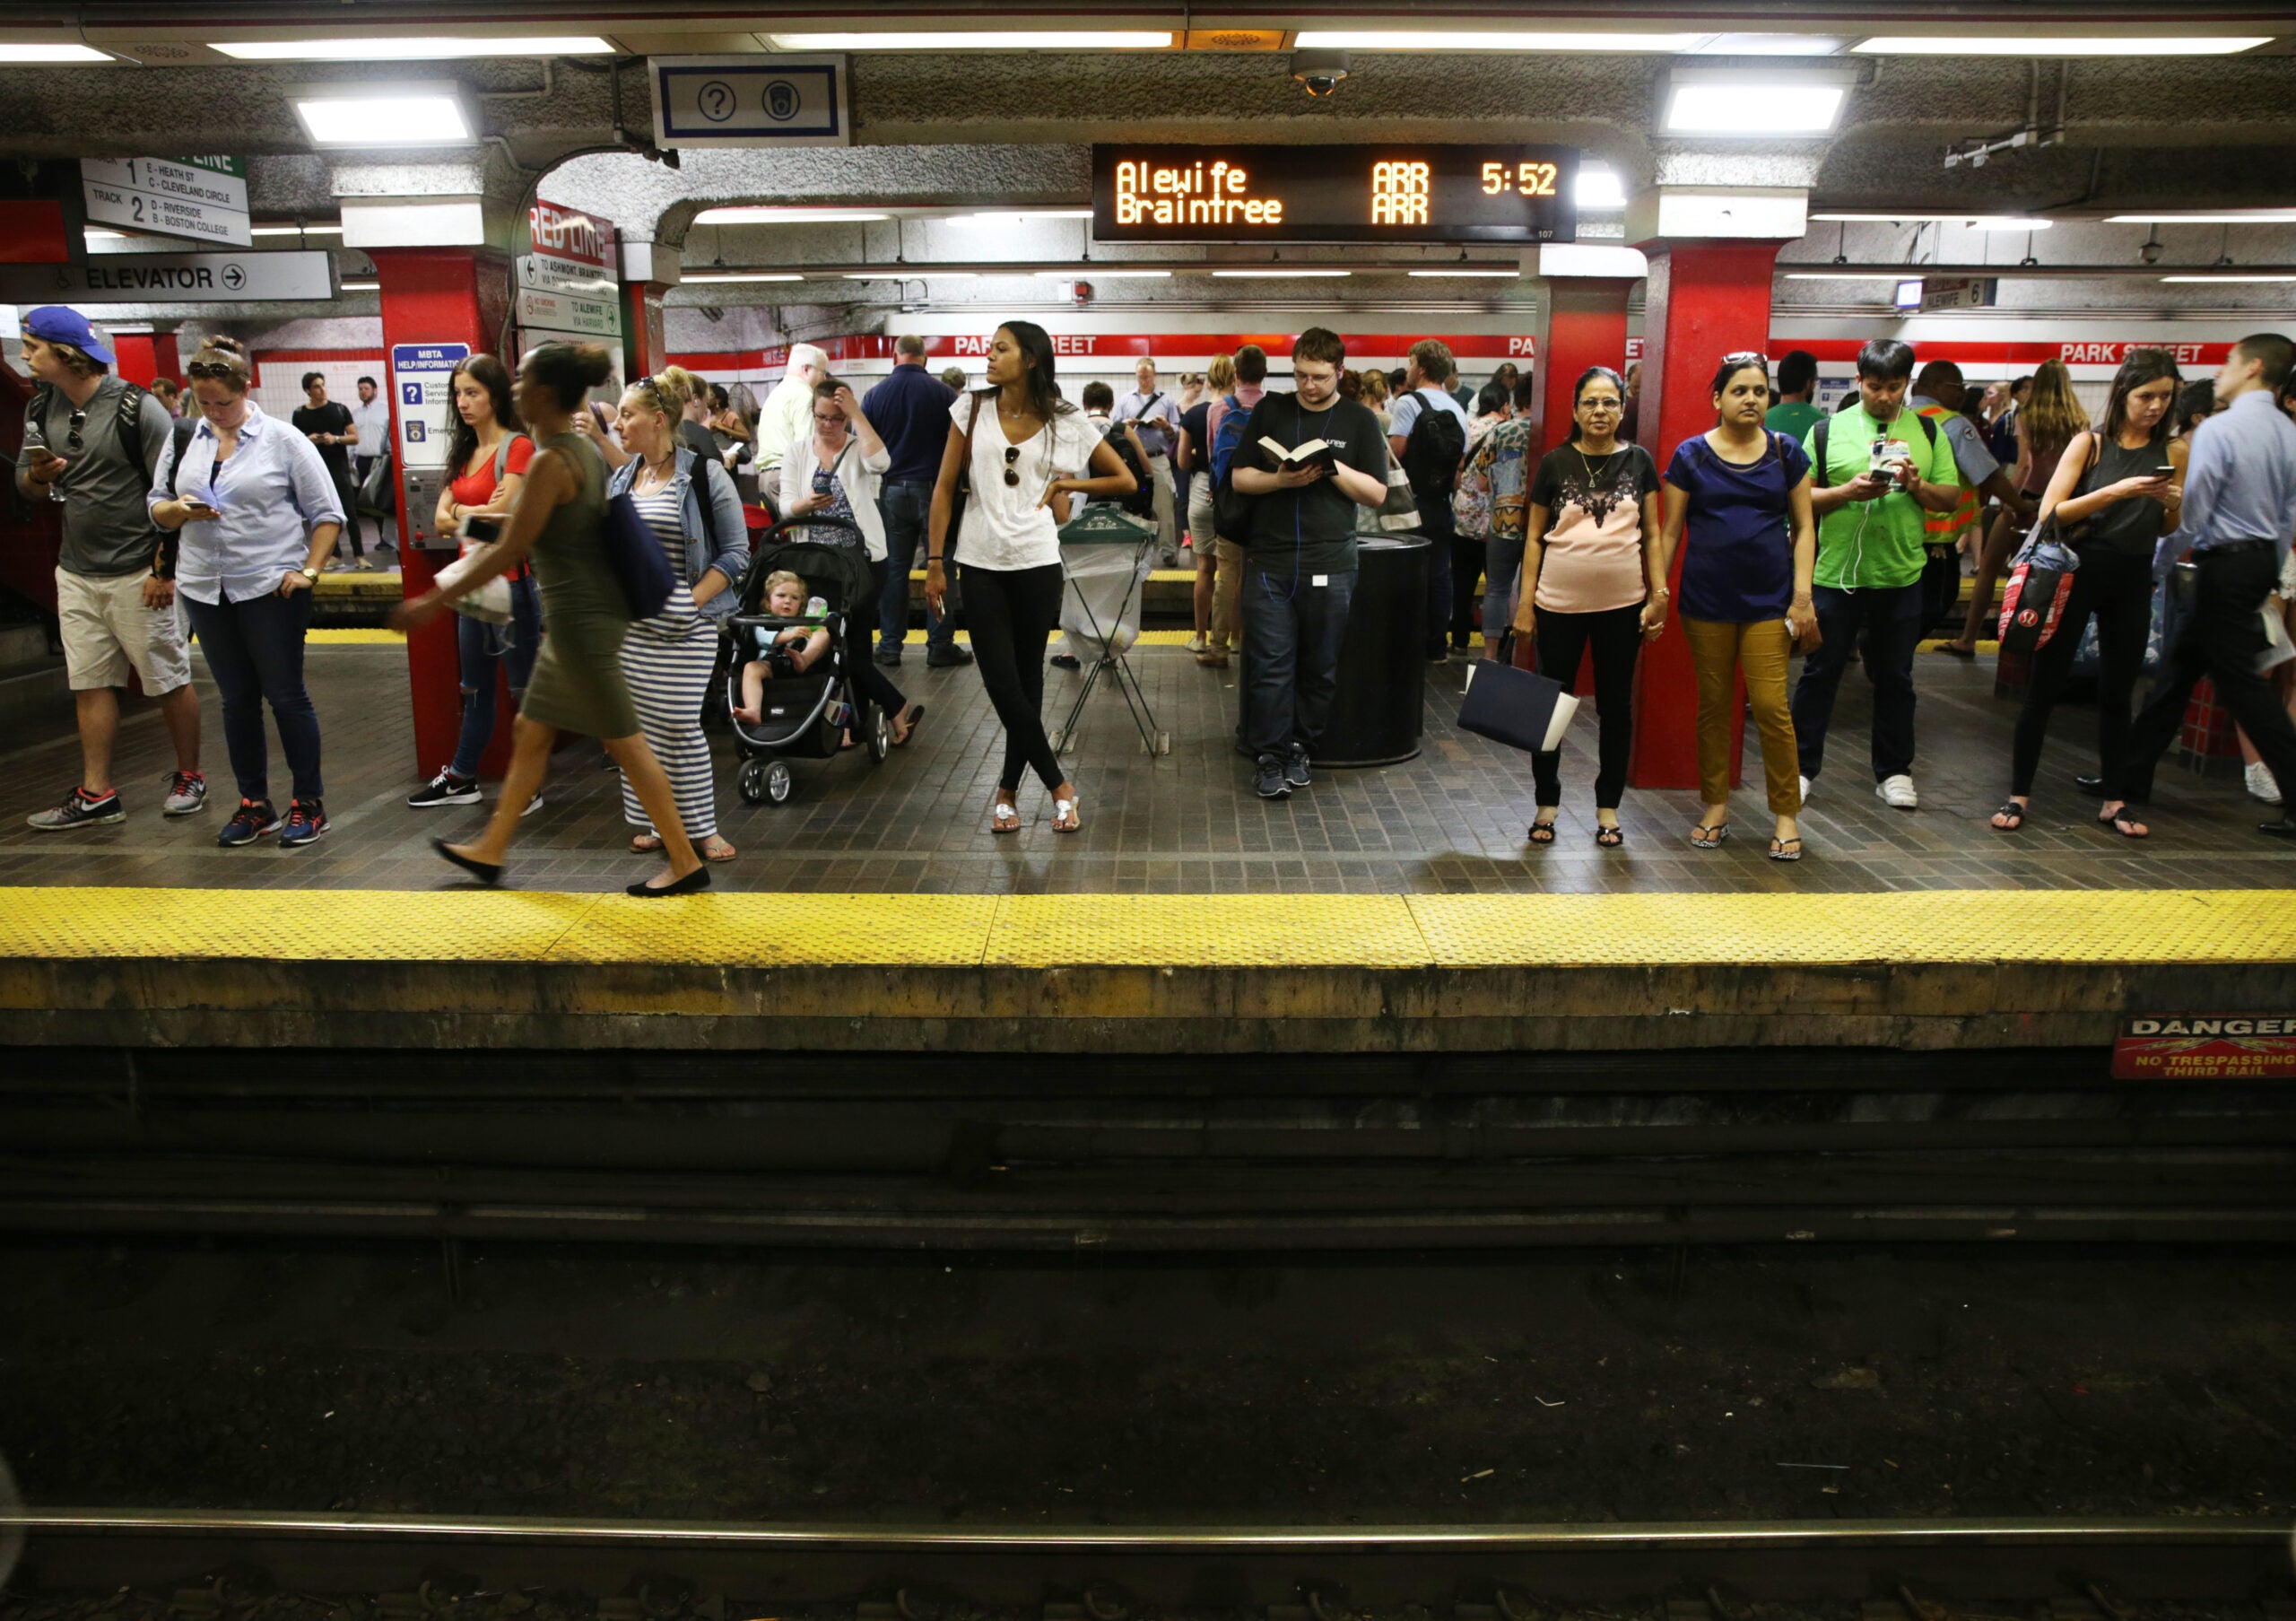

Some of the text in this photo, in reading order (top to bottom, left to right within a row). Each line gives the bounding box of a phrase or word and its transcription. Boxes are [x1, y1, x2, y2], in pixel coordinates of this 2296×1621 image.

[127, 160, 136, 184] 1
[147, 162, 152, 172] E
[159, 166, 185, 180] HEATH
[186, 170, 195, 181] ST
[1117, 161, 1429, 193] Alewife ARR
[1483, 163, 1557, 195] 5:52
[149, 178, 154, 187] C
[161, 180, 204, 198] CLEVELAND
[205, 188, 230, 204] CIRCLE
[93, 189, 144, 222] TRACK 2
[151, 200, 157, 210] D
[164, 202, 202, 218] RIVERSIDE
[1117, 192, 1428, 224] Braintree ARR
[152, 214, 158, 223] B
[165, 215, 196, 231] BOSTON
[196, 221, 228, 236] COLLEGE
[530, 207, 607, 260] RED LINE
[1538, 231, 1553, 239] 107
[541, 259, 548, 270] TO
[87, 267, 213, 289] ELEVATOR
[542, 275, 551, 286] VIA
[1971, 283, 1979, 303] 6
[571, 301, 578, 312] TO
[580, 303, 603, 317] ALEWIFE
[954, 336, 993, 354] PAR
[1509, 337, 1535, 355] PA
[2060, 344, 2116, 362] PARK
[418, 350, 443, 359] MBTA
[397, 360, 459, 370] HELP/INFORMATIO
[2135, 1055, 2296, 1066] NO TRESPASSING
[2163, 1066, 2266, 1076] THIRD RAIL
